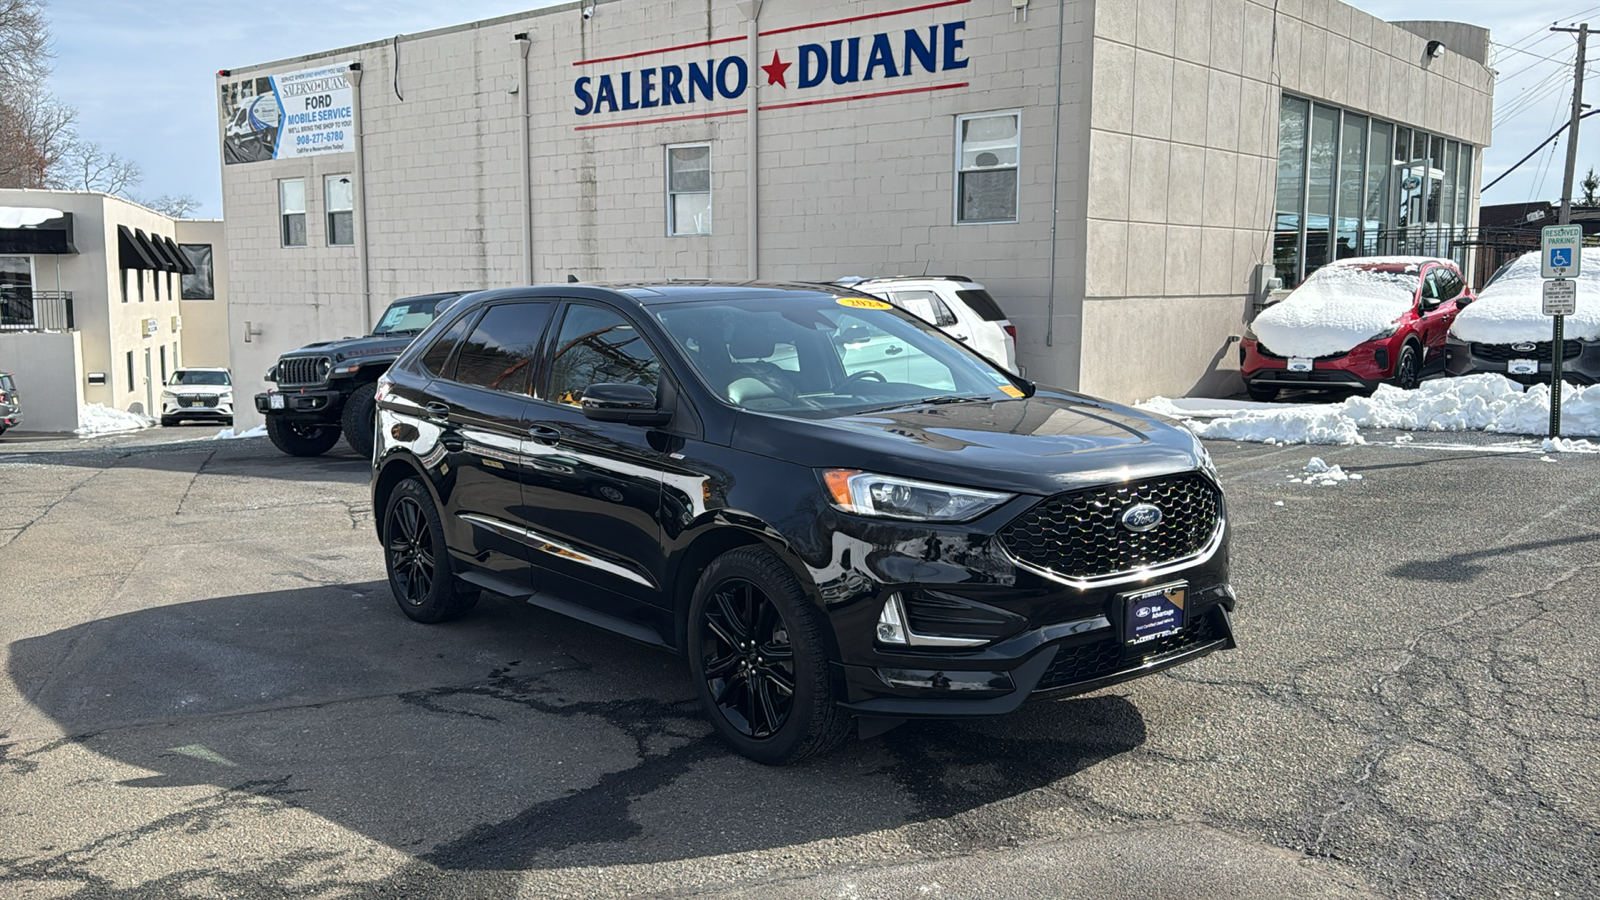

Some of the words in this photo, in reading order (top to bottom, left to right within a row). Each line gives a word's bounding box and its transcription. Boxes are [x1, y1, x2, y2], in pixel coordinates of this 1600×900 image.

[574, 55, 748, 116] SALERNO
[797, 20, 970, 90] DUANE
[283, 81, 318, 97] SALERNO
[321, 77, 349, 91] DUANE
[305, 94, 332, 110] FORD
[288, 111, 317, 125] MOBILE
[318, 106, 352, 121] SERVICE
[296, 130, 344, 145] 908-277-6780
[1545, 228, 1579, 237] RESERVED
[846, 299, 883, 308] 2024
[1134, 510, 1155, 525] Ford
[1152, 609, 1174, 619] Advantage
